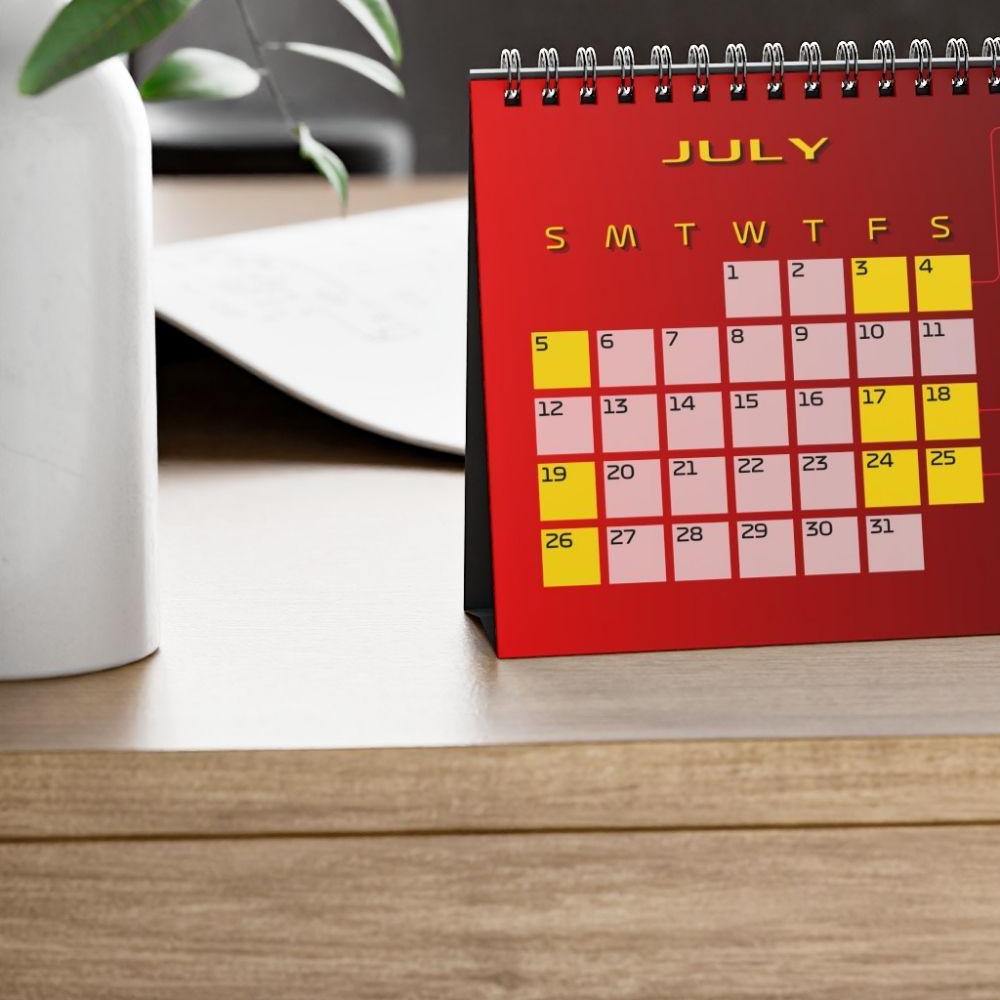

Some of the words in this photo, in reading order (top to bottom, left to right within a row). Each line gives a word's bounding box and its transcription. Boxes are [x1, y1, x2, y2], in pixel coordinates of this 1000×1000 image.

[662, 137, 828, 164] JULY
[545, 226, 565, 250] S
[605, 224, 637, 248] M
[674, 222, 696, 246] T
[732, 220, 766, 244] W
[802, 219, 824, 242] T
[868, 217, 887, 240] F
[930, 215, 950, 239] S
[727, 264, 739, 280] 1
[791, 262, 805, 278] 2
[855, 260, 868, 276] 3
[919, 258, 933, 274] 4
[535, 336, 548, 352] 5
[600, 333, 614, 349] 6
[665, 330, 679, 347] 7
[731, 328, 745, 344] 8
[794, 326, 809, 342] 9
[859, 323, 885, 340] 10
[922, 321, 946, 338] 11
[538, 400, 564, 417] 12
[603, 398, 628, 414] 13
[670, 395, 696, 412] 14
[734, 393, 759, 409] 15
[799, 391, 824, 407] 16
[862, 388, 886, 405] 17
[926, 386, 951, 402] 18
[541, 466, 567, 483] 19
[607, 464, 635, 481] 20
[673, 460, 698, 476] 21
[738, 457, 764, 474] 22
[802, 455, 828, 472] 23
[866, 452, 894, 469] 24
[930, 450, 956, 466] 25
[545, 532, 573, 549] 26
[610, 528, 636, 545] 27
[676, 526, 703, 543] 28
[741, 523, 768, 540] 29
[805, 520, 833, 537] 30
[869, 518, 895, 534] 31
